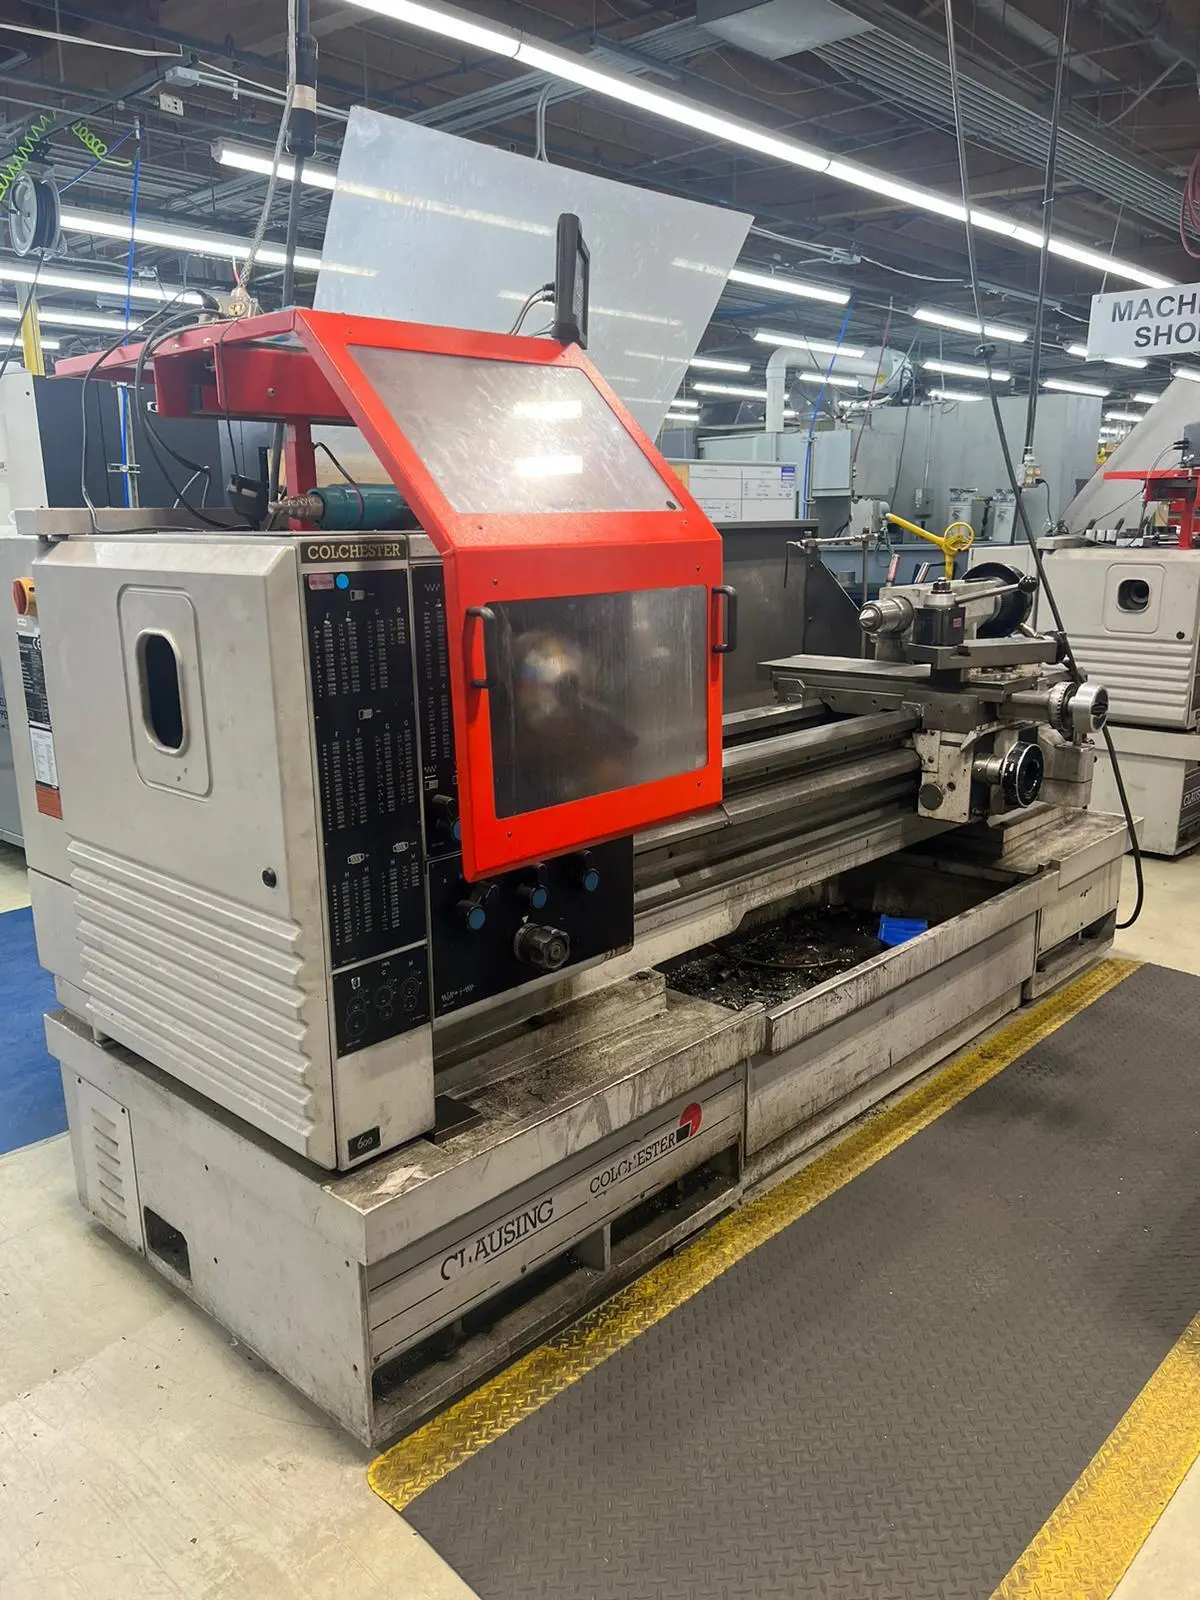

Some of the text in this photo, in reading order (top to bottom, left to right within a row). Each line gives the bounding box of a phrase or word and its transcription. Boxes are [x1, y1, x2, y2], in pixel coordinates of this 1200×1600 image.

[1111, 293, 1200, 322] MACH
[1134, 322, 1200, 348] SHO
[307, 543, 400, 560] COLCHESTER
[357, 1135, 373, 1149] 600
